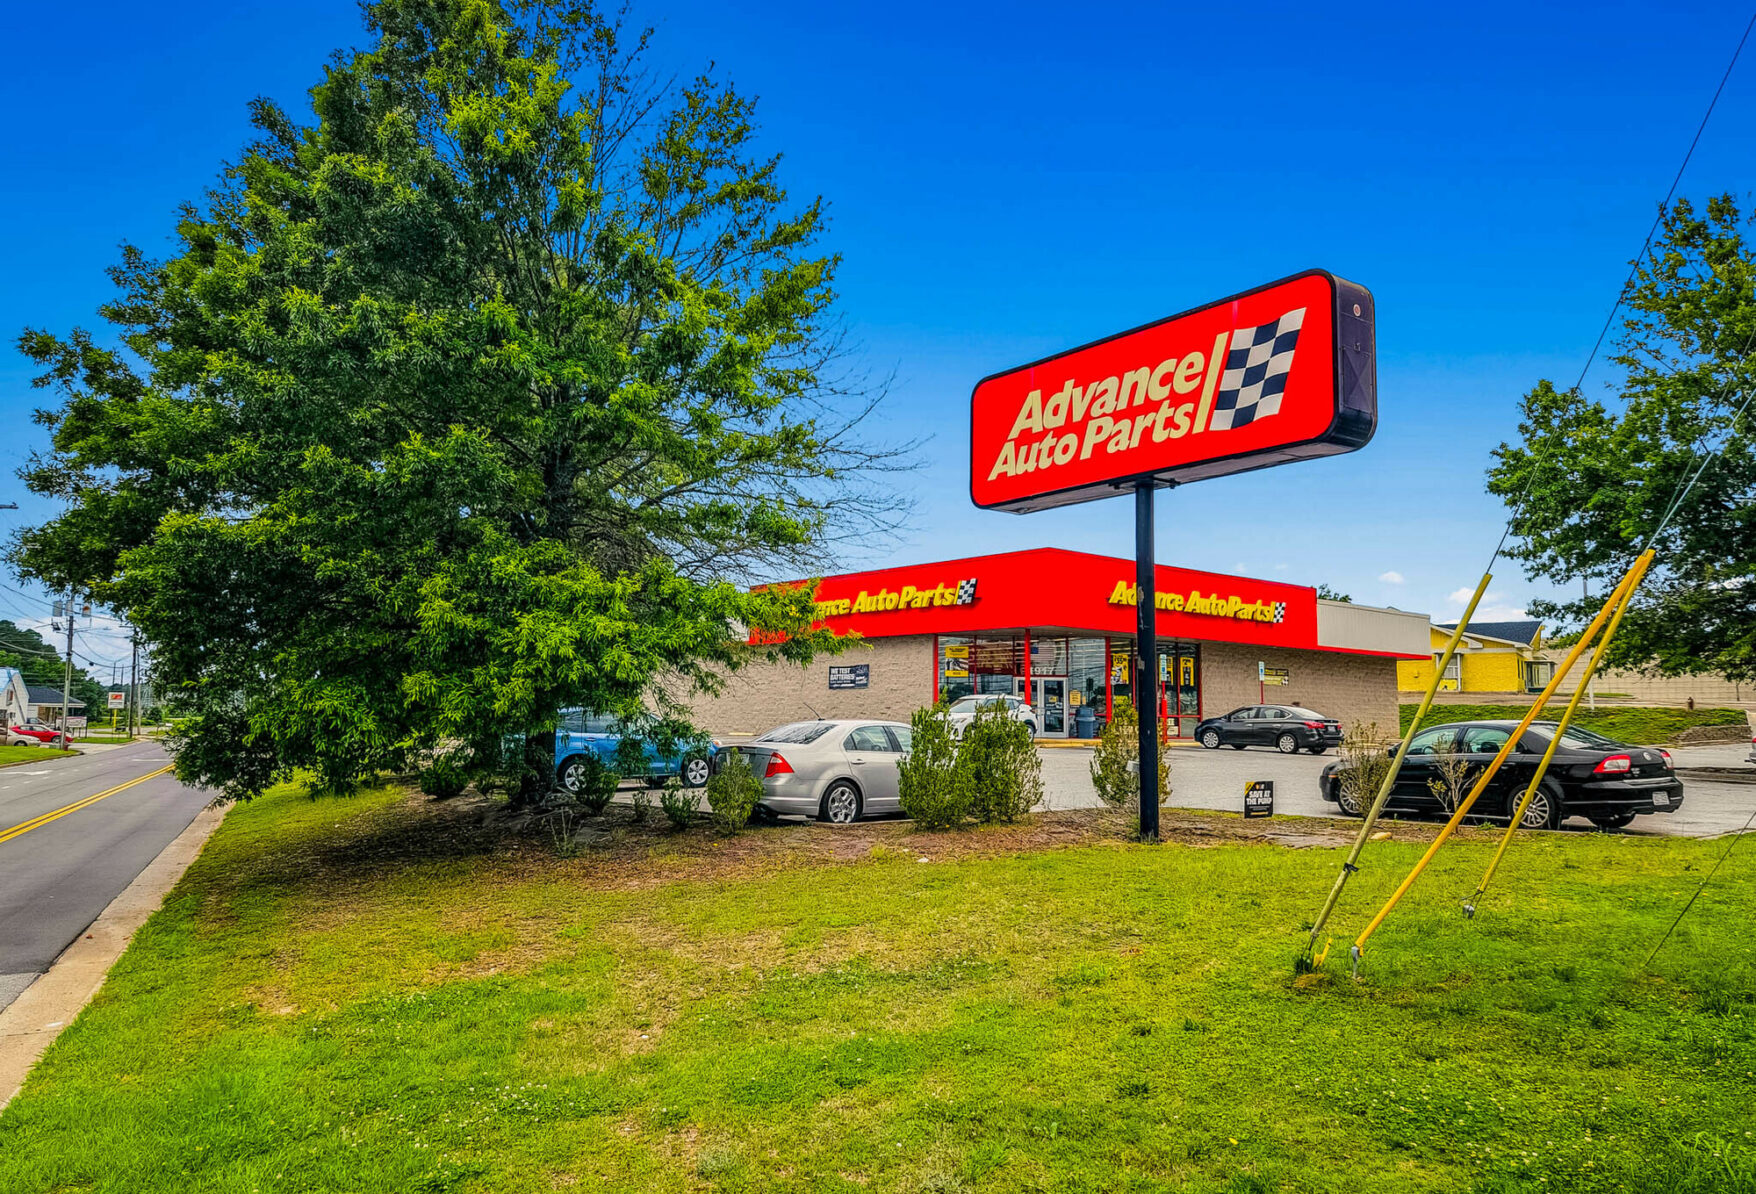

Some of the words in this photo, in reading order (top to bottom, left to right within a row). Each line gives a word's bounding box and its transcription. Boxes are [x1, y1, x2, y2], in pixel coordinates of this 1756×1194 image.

[1006, 351, 1205, 441] Advance
[987, 430, 1079, 481] Auto
[1079, 399, 1193, 460] Parts
[851, 588, 900, 614] Auto
[898, 582, 957, 609] Parts
[1108, 580, 1185, 611] Adnce
[1183, 590, 1228, 617] Auto
[1226, 595, 1271, 622] Parts
